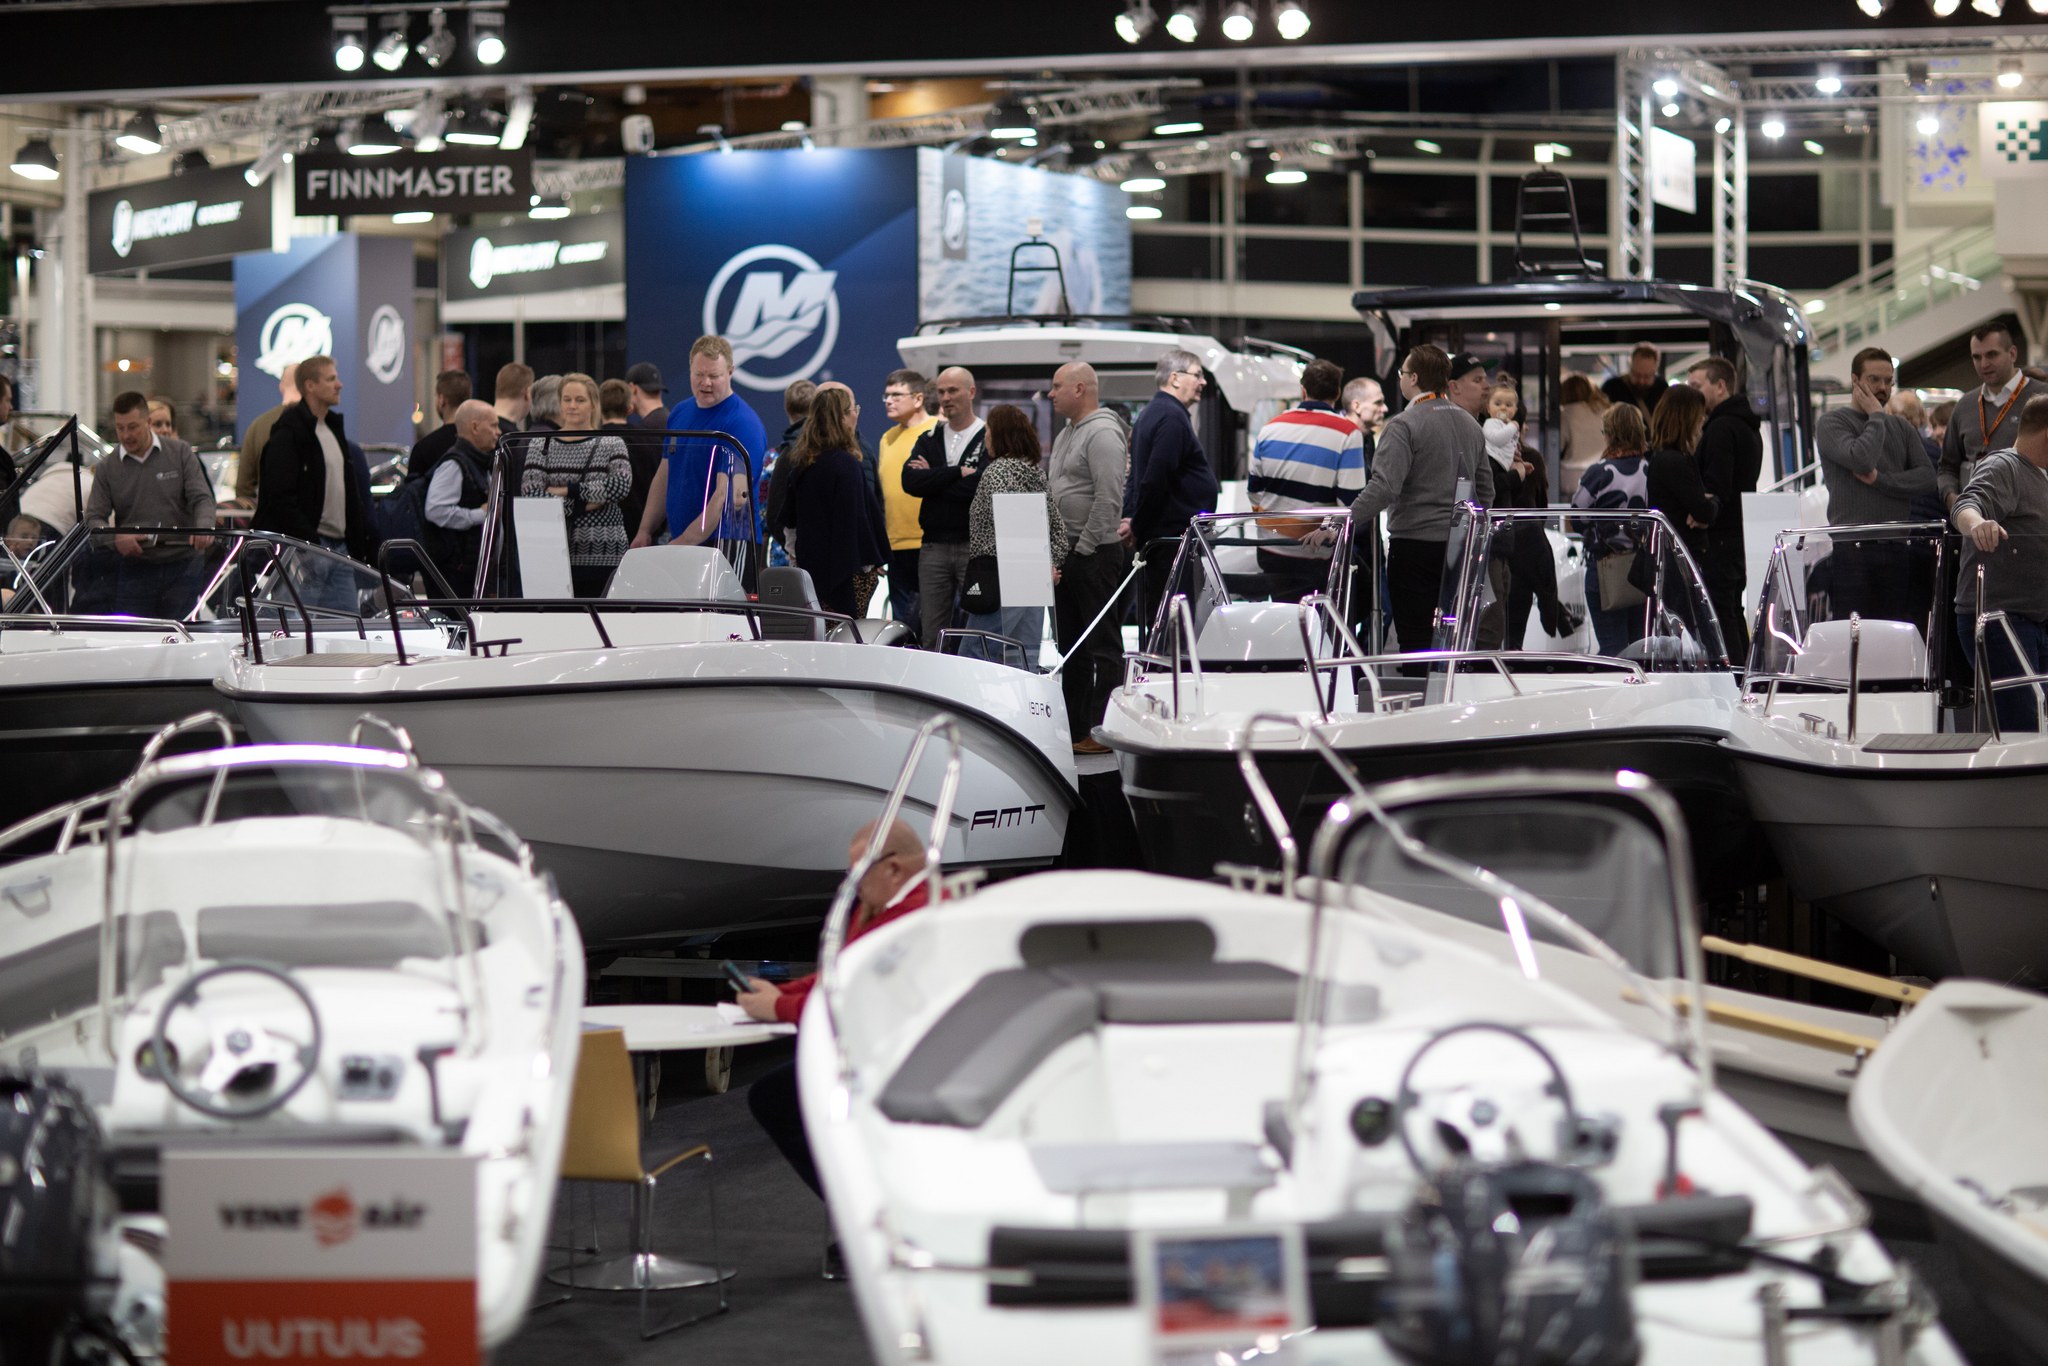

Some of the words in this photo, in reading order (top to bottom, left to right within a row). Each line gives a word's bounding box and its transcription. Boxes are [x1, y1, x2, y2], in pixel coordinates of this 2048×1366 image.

[307, 165, 516, 200] FINNMASTER
[970, 804, 1046, 831] AMT
[222, 1317, 426, 1359] UUTUUS
